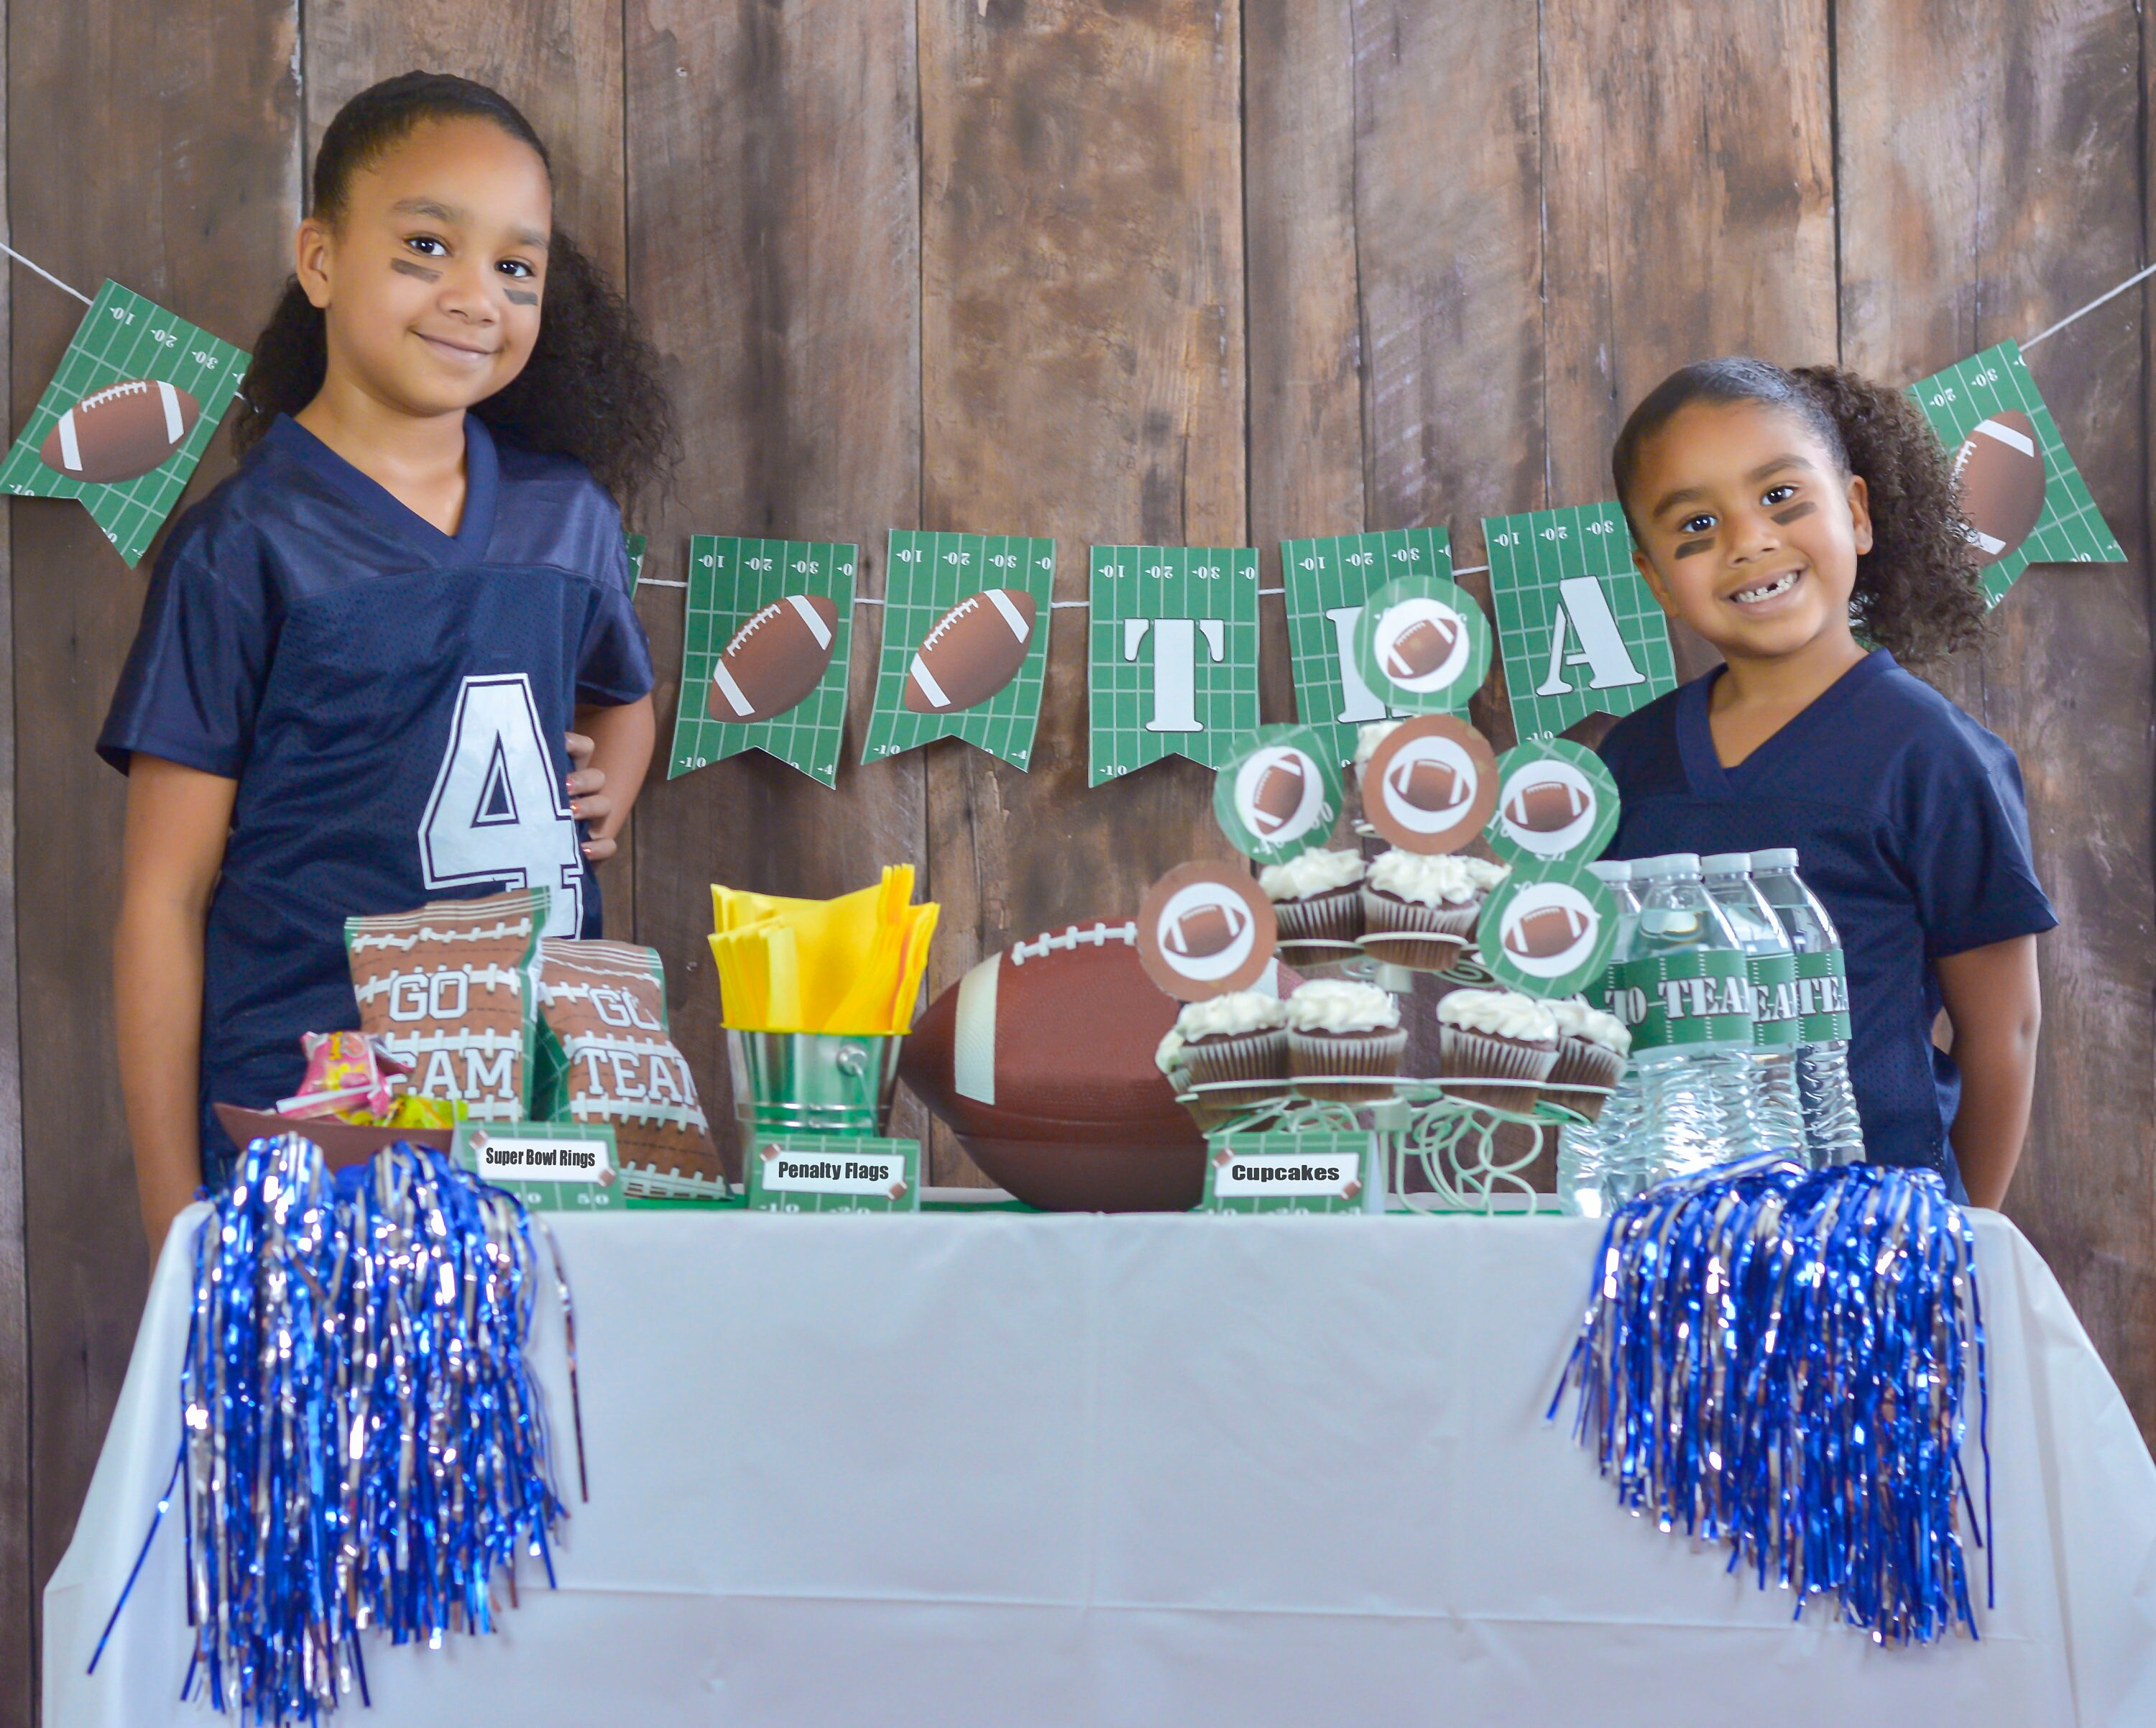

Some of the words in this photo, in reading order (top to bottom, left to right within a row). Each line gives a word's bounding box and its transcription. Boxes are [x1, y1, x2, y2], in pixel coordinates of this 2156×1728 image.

[418, 673, 584, 943] 4
[389, 970, 469, 1022] GO
[486, 1147, 524, 1166] Super
[526, 1149, 556, 1166] Bowl
[560, 1150, 595, 1169] Rings
[778, 1161, 842, 1180] Penalty
[845, 1162, 889, 1181] Flags
[1232, 1164, 1340, 1182] Cupcakes
